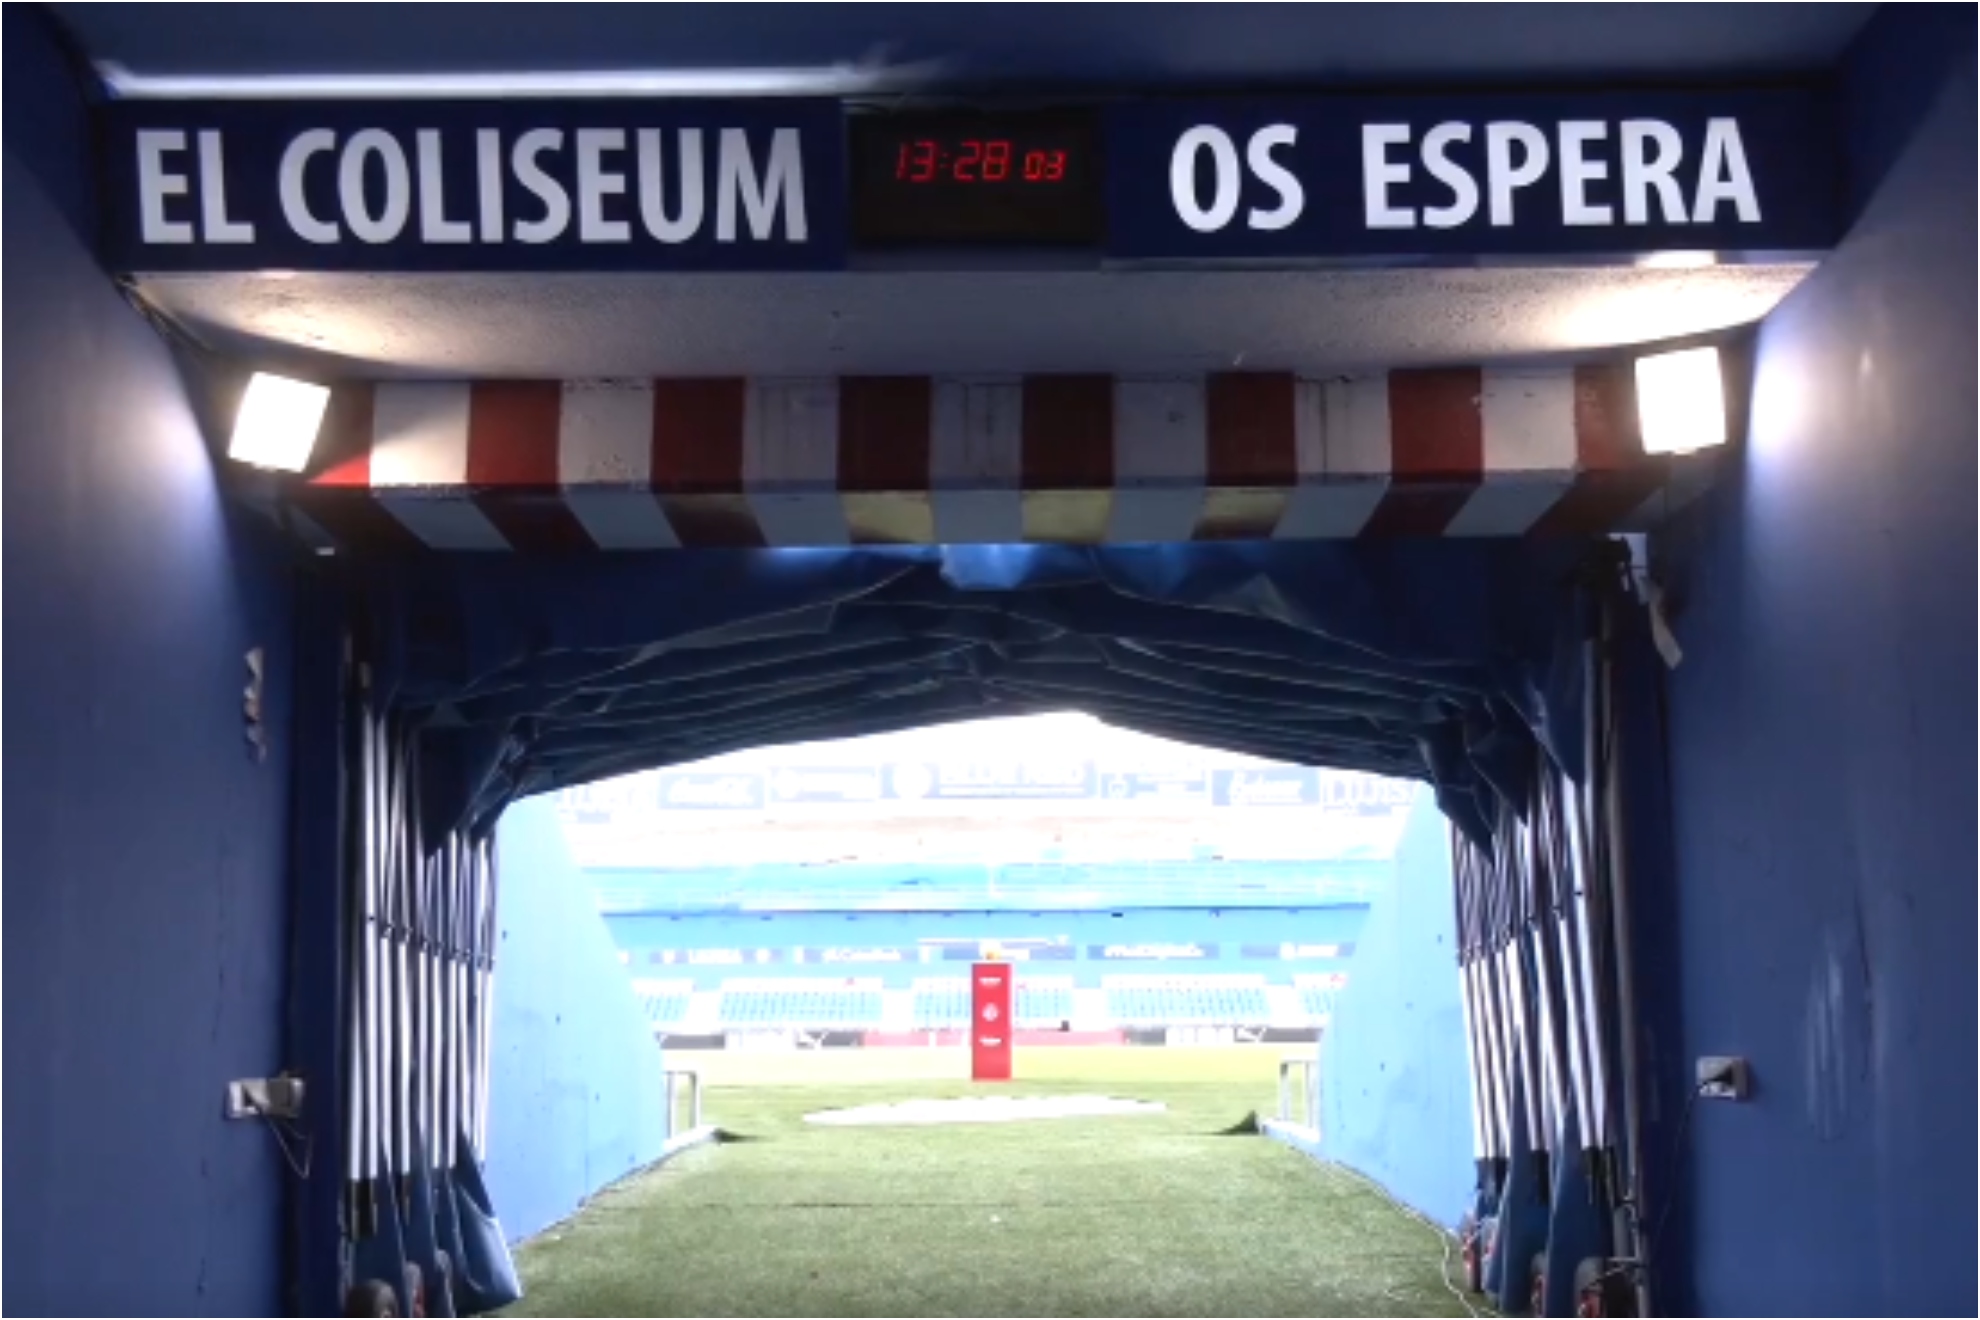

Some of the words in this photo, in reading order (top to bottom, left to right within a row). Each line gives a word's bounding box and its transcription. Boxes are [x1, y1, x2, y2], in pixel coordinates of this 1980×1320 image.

[138, 131, 254, 243] EL
[280, 129, 806, 243] COLISEUM
[896, 139, 1013, 183] 13:28
[1022, 149, 1067, 183] 03
[1170, 124, 1304, 232] OS
[1362, 118, 1761, 228] ESPERA
